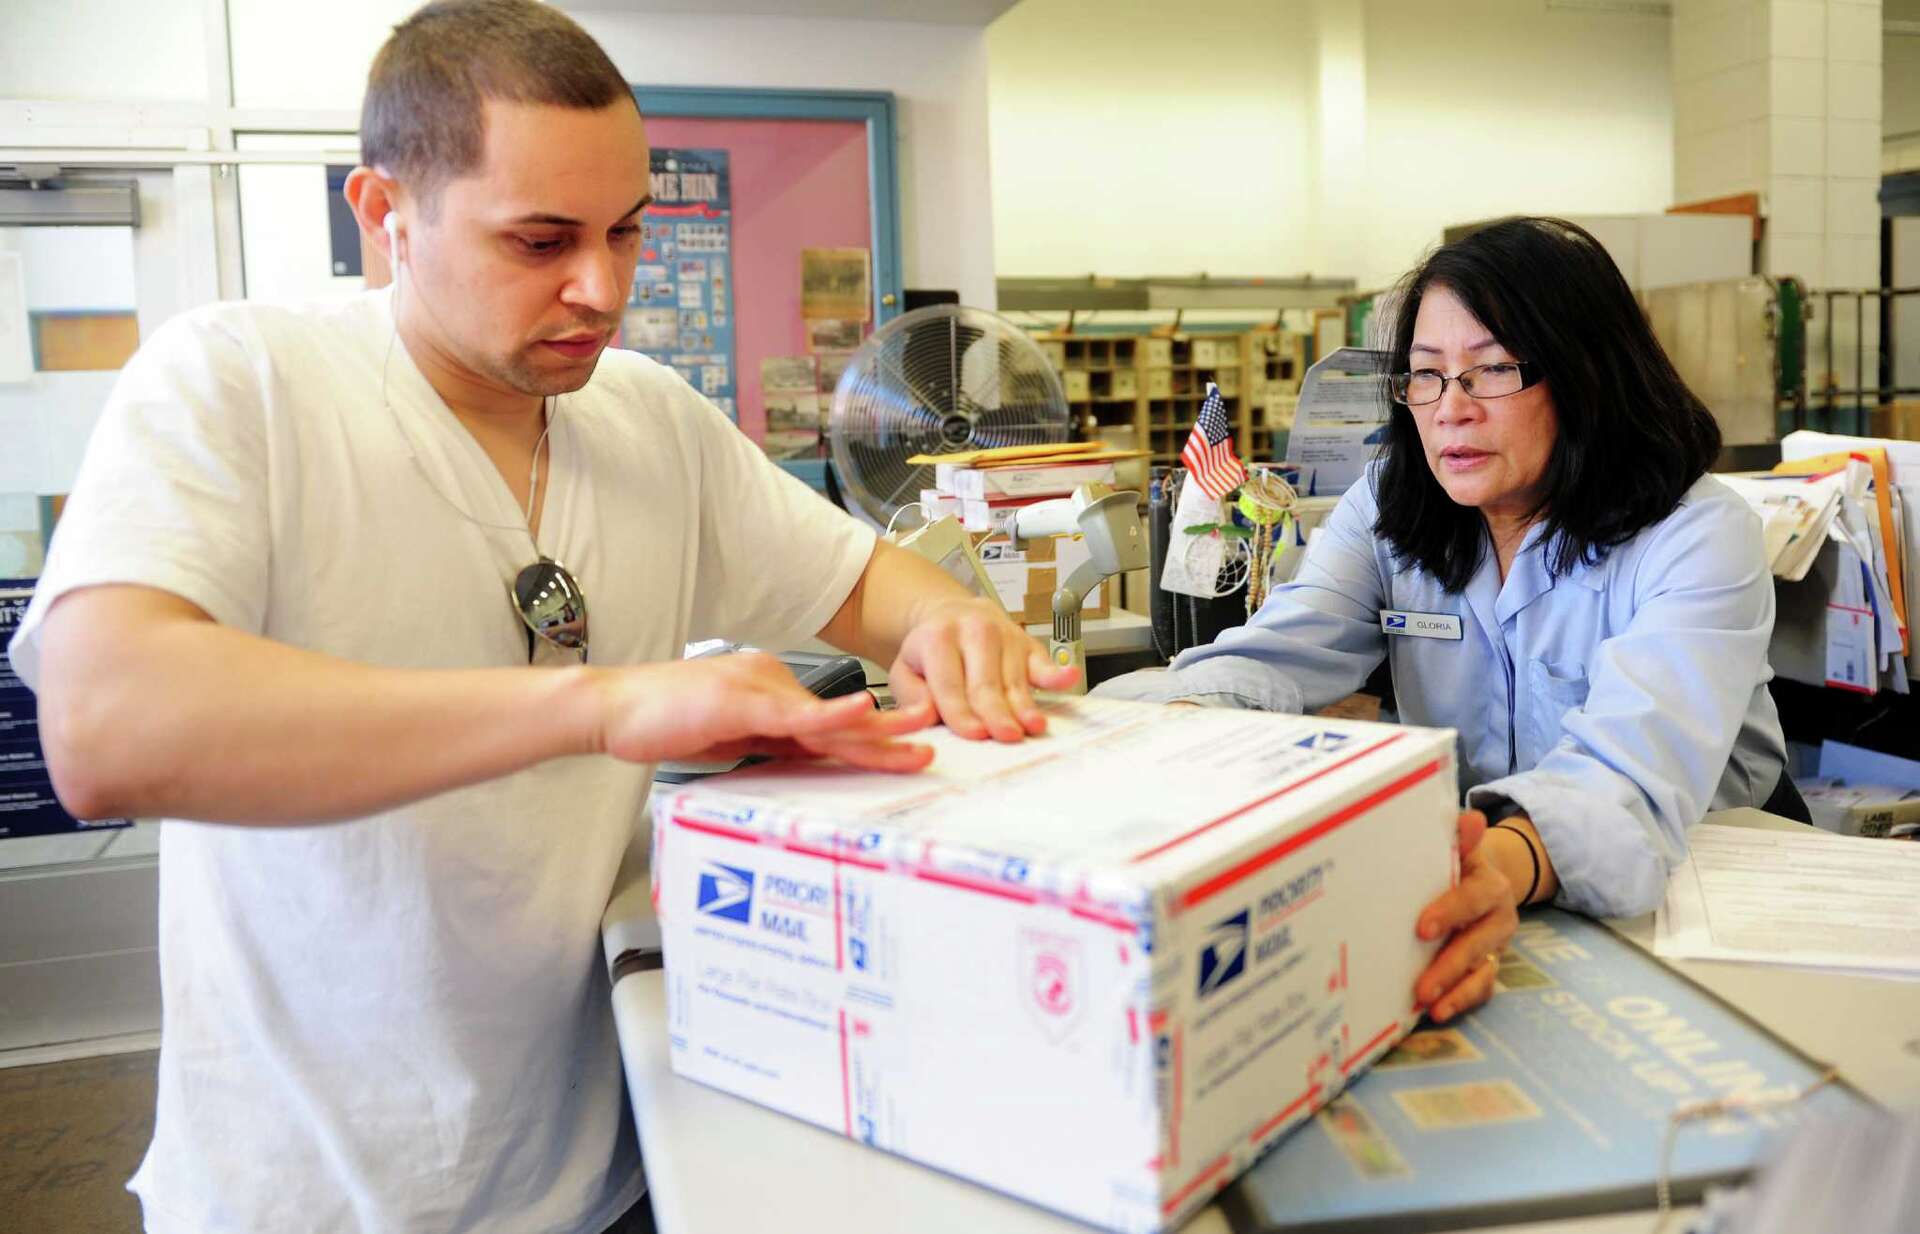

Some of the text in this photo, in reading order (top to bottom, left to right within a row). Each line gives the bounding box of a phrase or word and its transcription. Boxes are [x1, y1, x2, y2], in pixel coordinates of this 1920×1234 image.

[1416, 621, 1452, 631] GLORIA
[763, 873, 829, 905] PRIORI
[760, 910, 809, 942] MAIL
